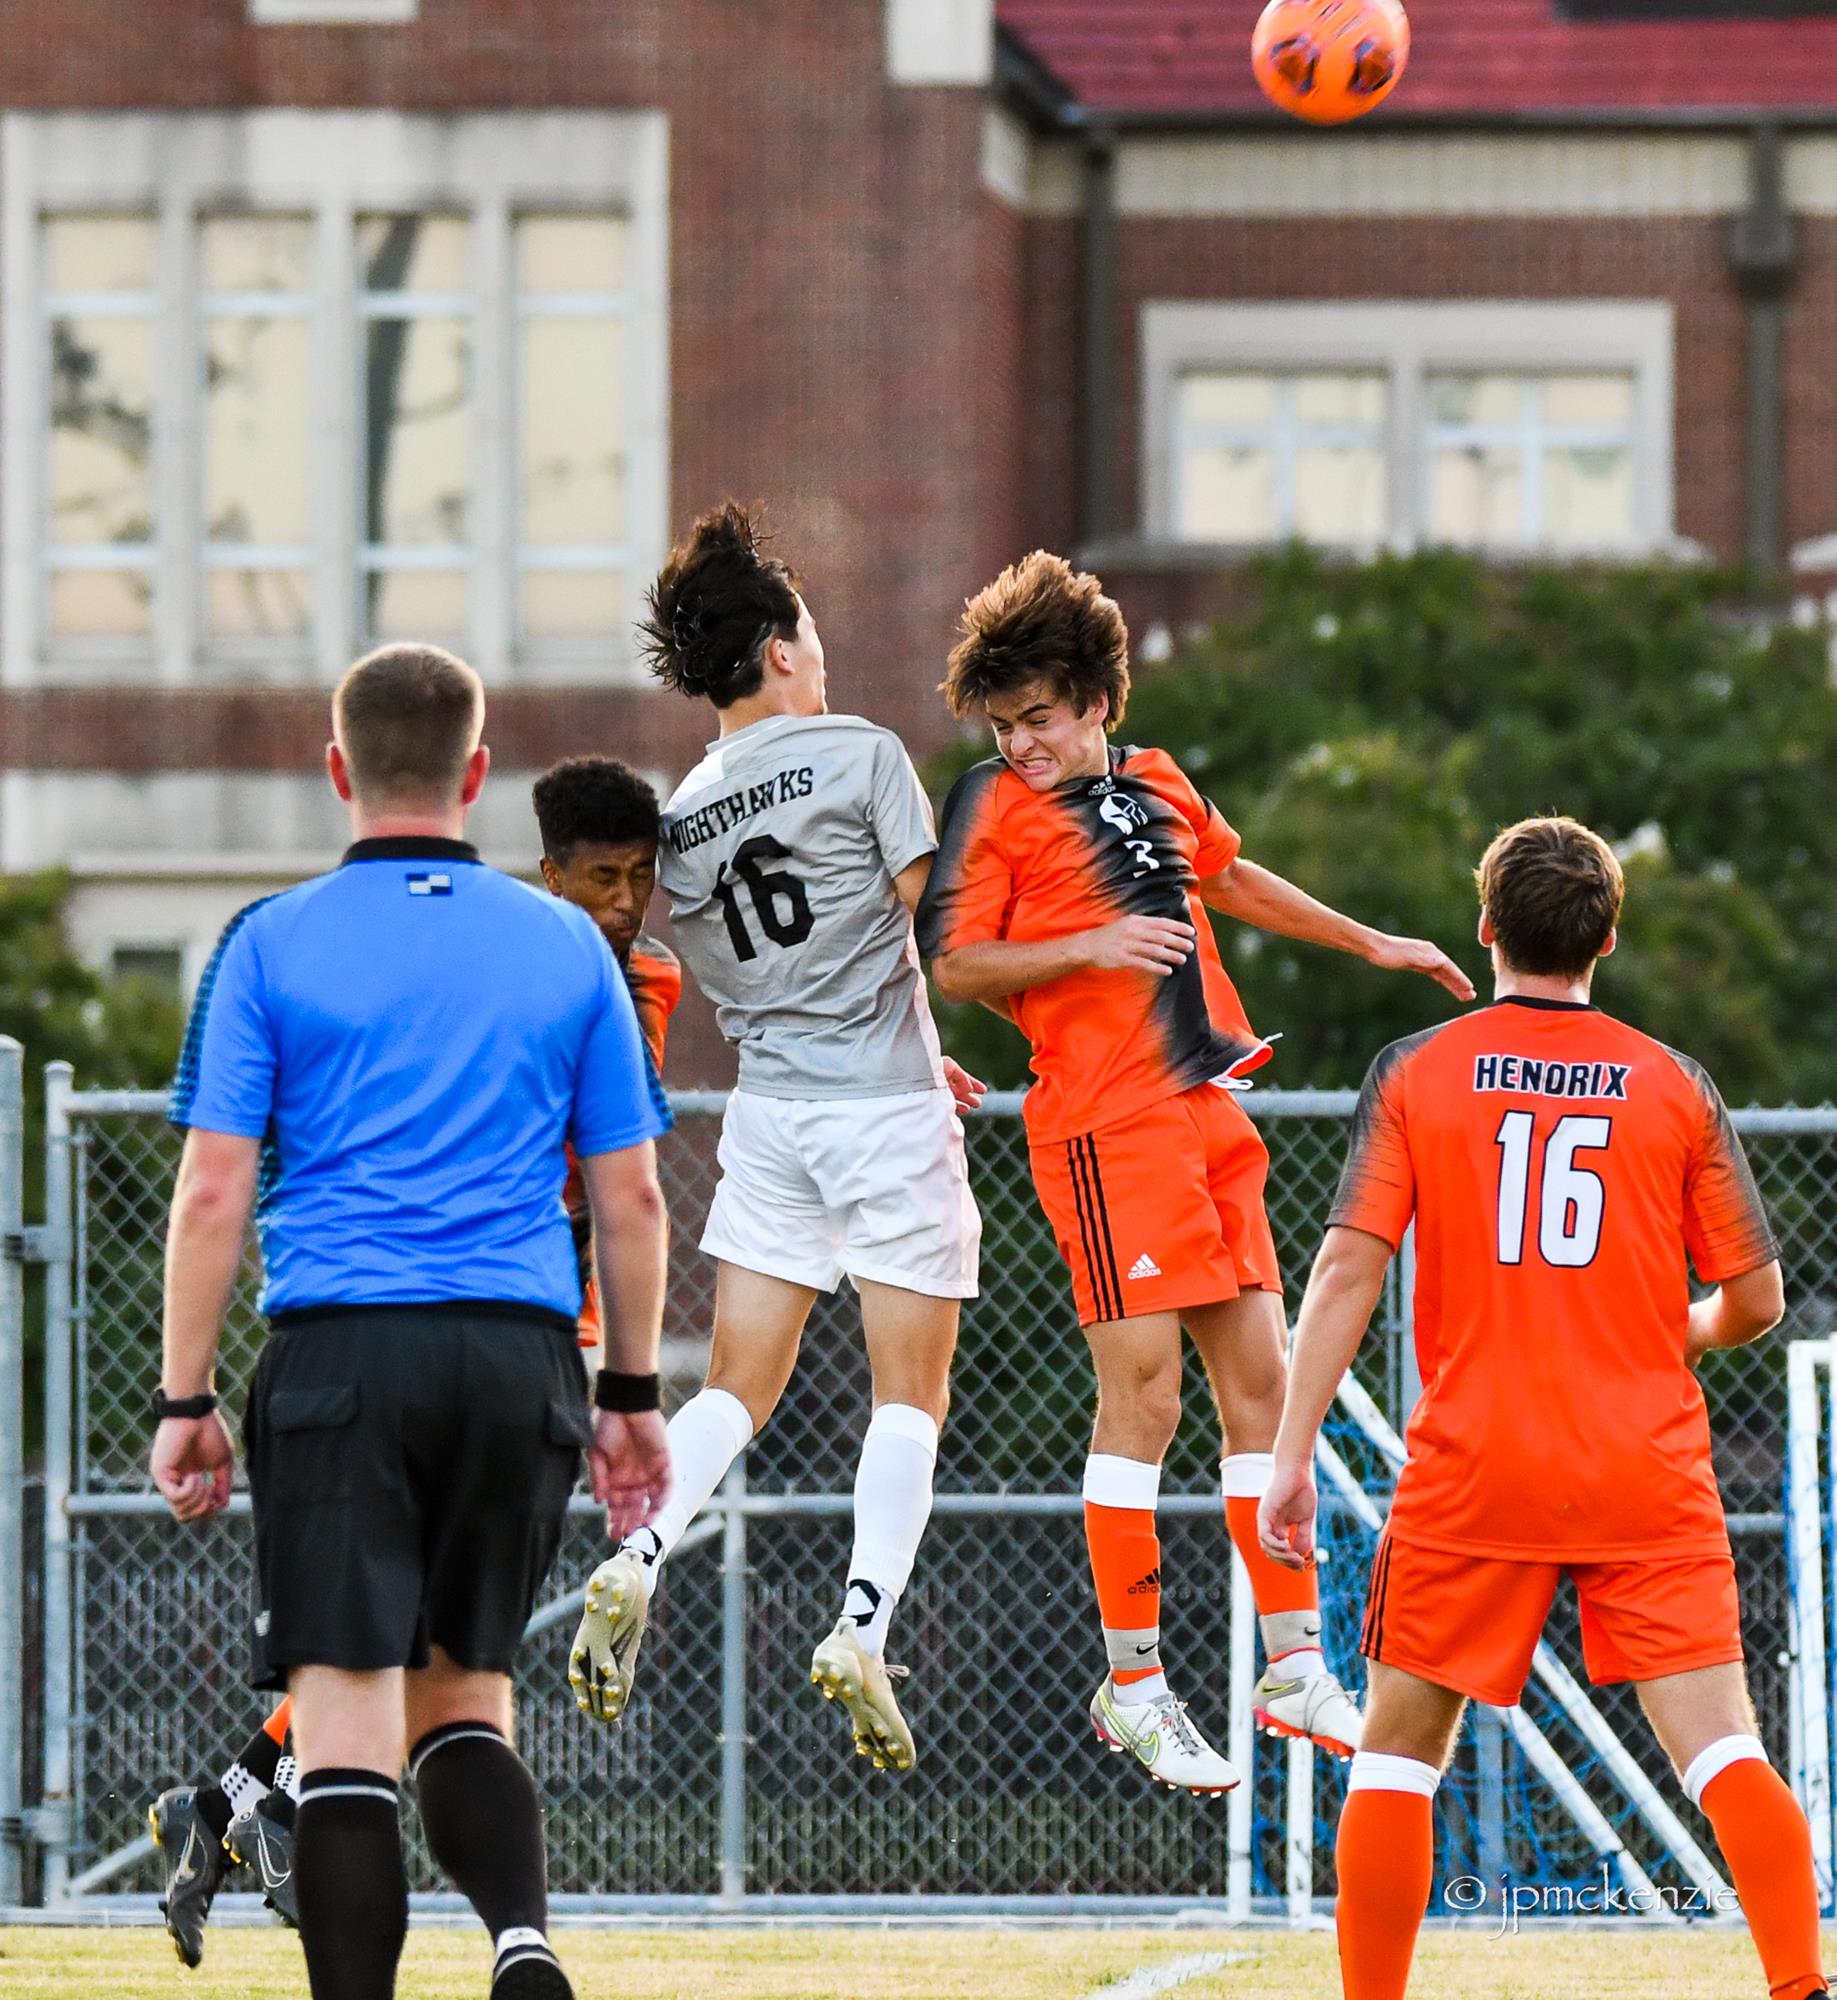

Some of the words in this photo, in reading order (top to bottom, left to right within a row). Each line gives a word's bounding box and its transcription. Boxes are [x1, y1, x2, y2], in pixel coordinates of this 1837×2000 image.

[669, 766, 814, 855] NIGHTHAWKS
[1123, 840, 1160, 879] 3
[711, 834, 815, 963] 16
[1473, 1054, 1632, 1100] HENDRIX
[1494, 1109, 1613, 1268] 16
[1127, 1267, 1162, 1280] adidas
